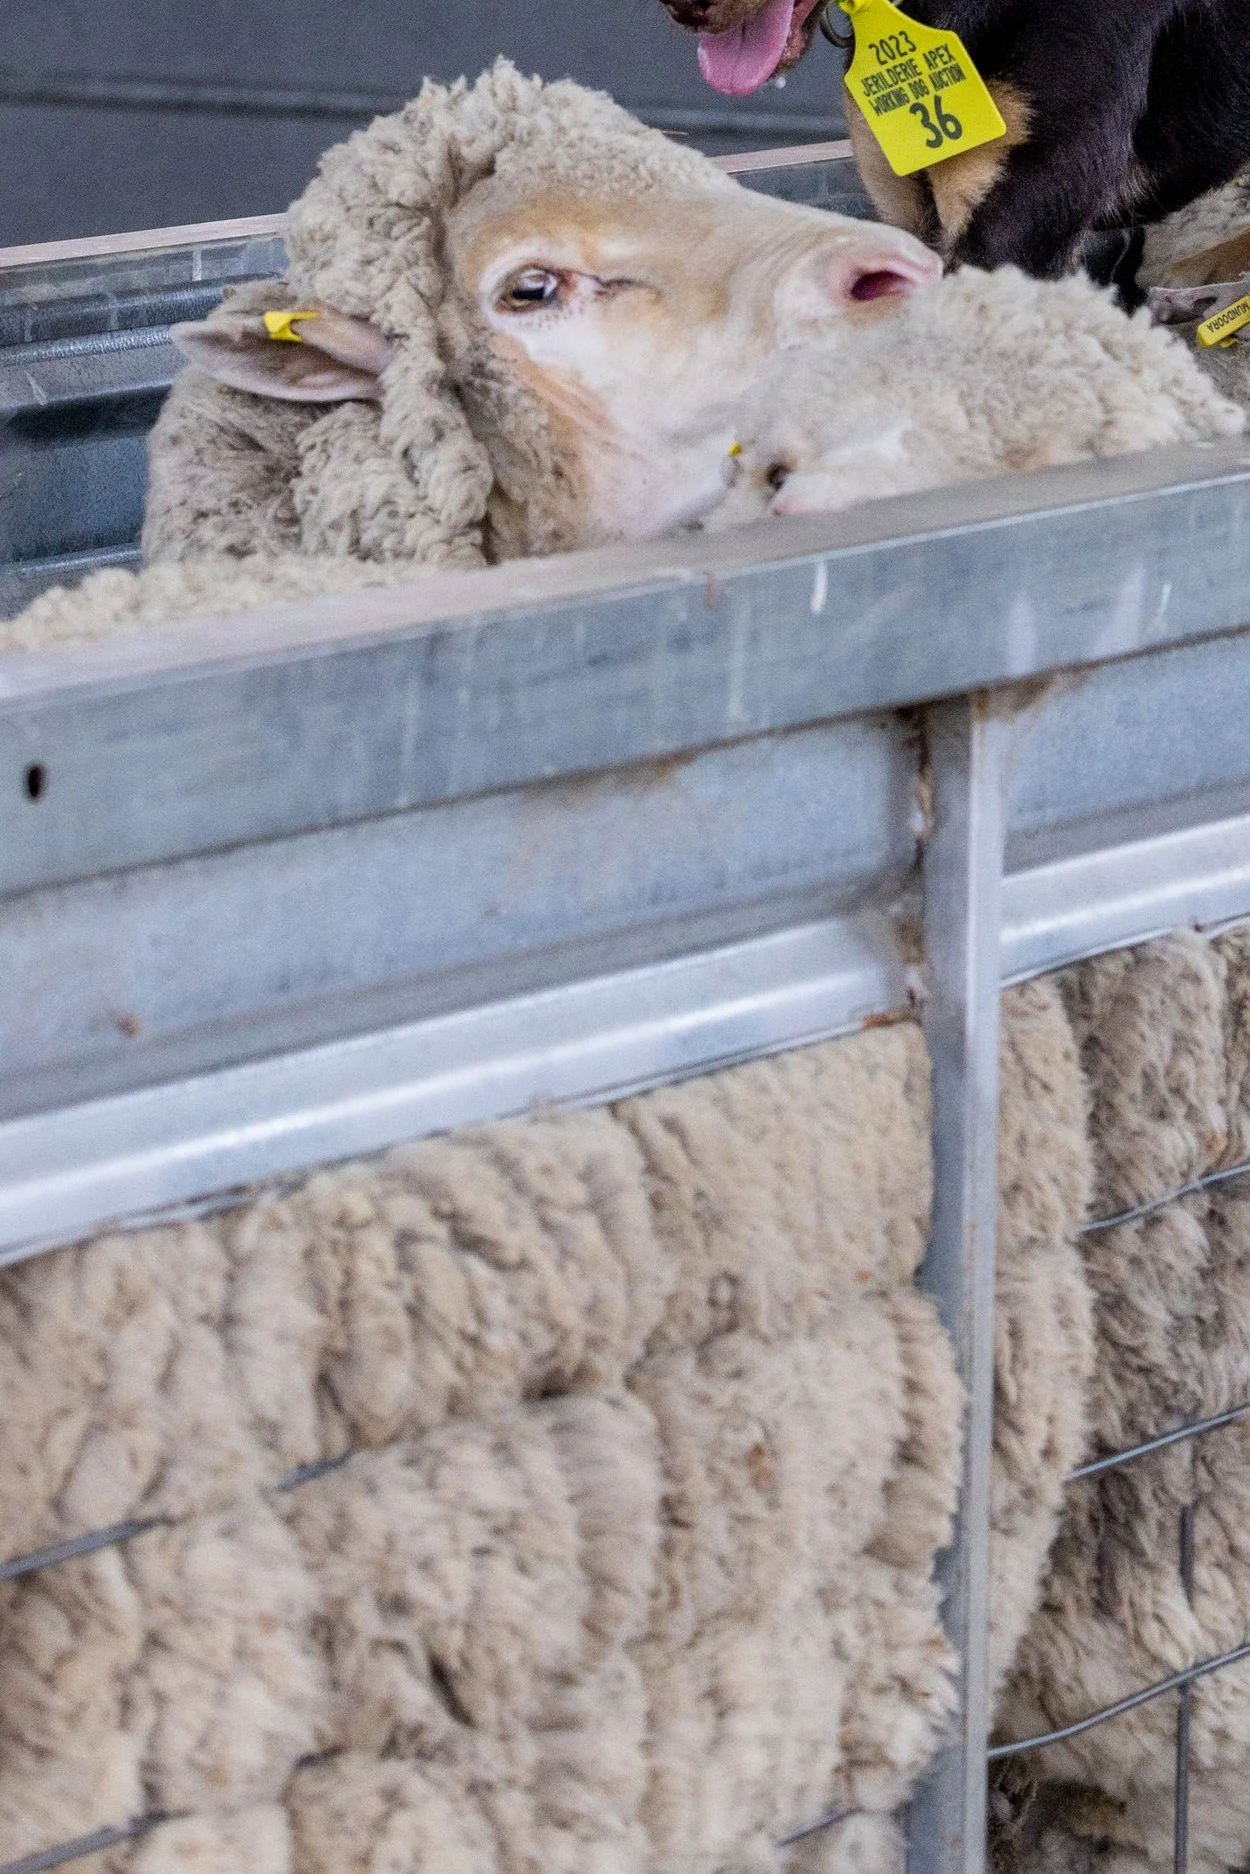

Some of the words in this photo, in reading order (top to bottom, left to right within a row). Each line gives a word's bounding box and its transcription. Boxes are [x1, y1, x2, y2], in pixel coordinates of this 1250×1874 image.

[861, 57, 922, 97] JERILDERIE
[922, 43, 956, 71] APEX
[868, 30, 917, 66] 2023
[868, 86, 910, 116] WORKING
[908, 78, 930, 100] DOG
[928, 62, 967, 92] AUCTION
[909, 93, 963, 148] 36
[1206, 300, 1250, 333] MUNDOORA
